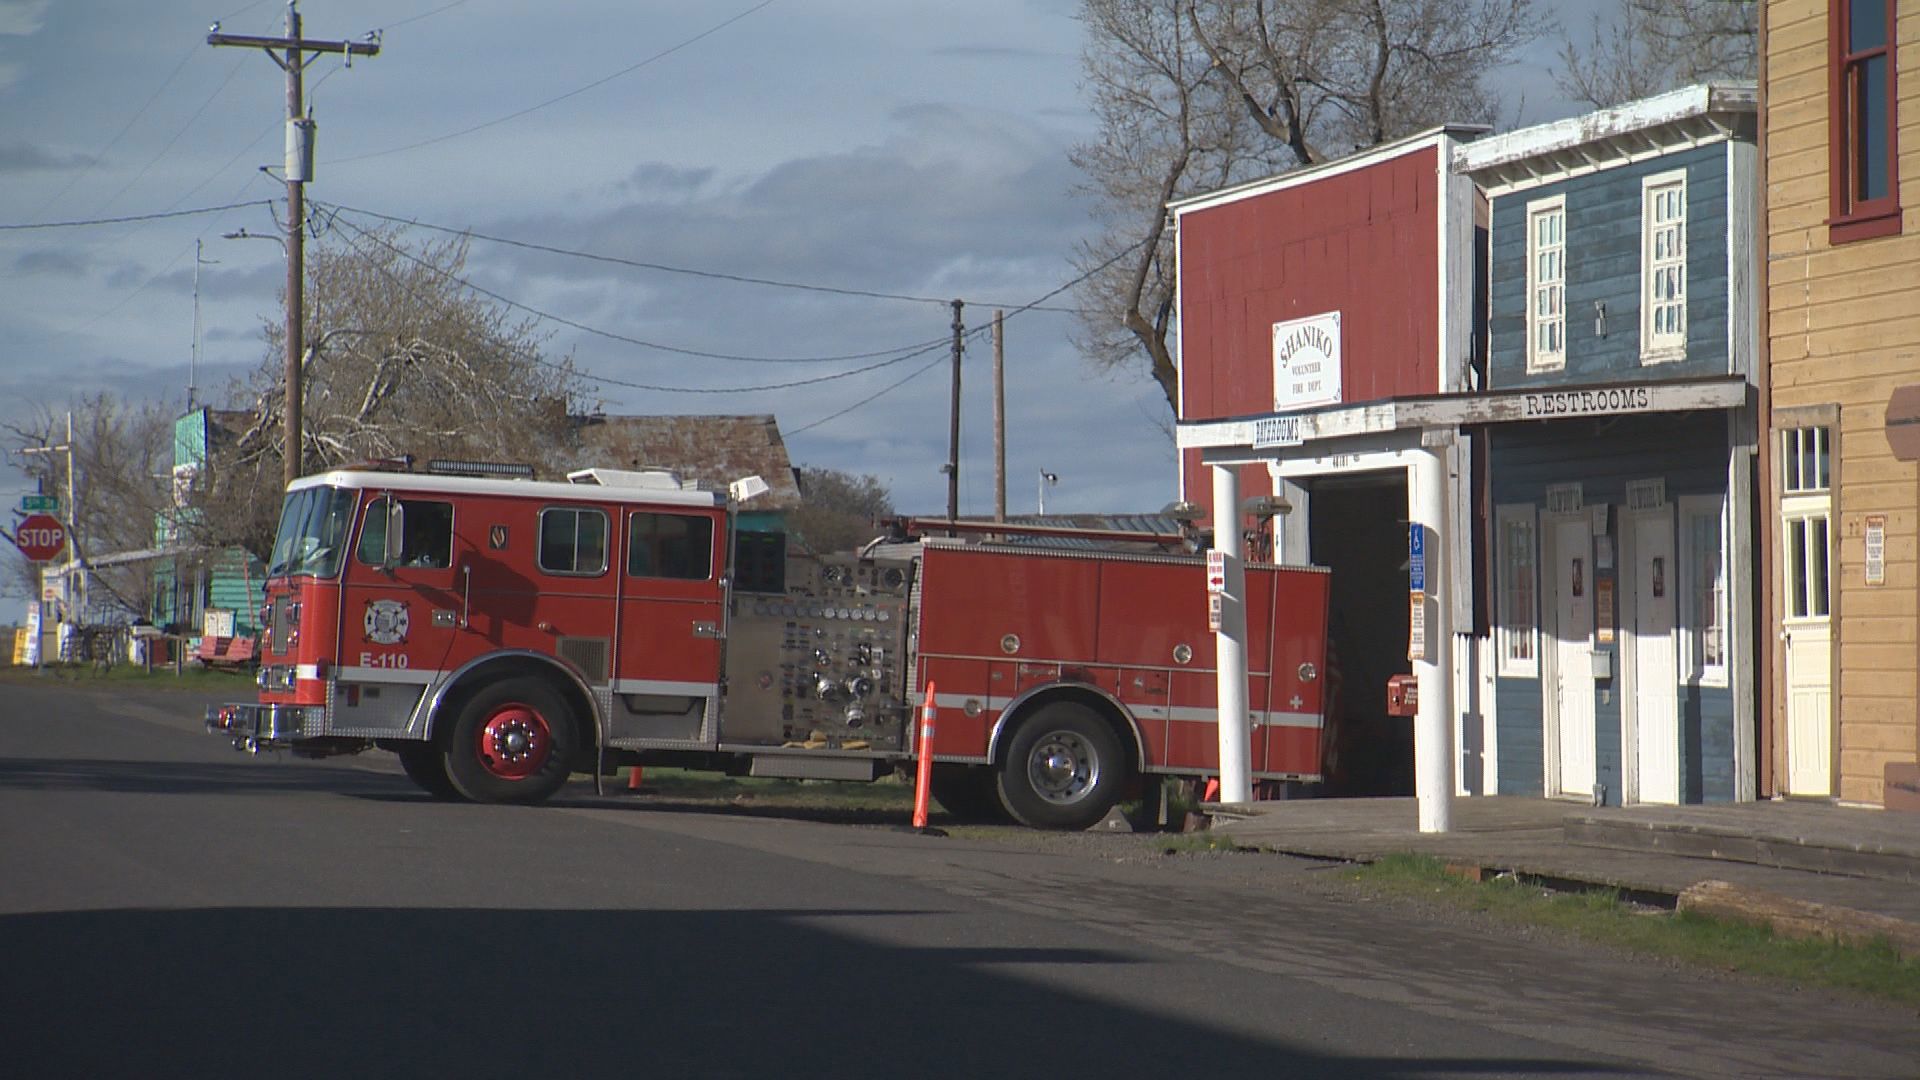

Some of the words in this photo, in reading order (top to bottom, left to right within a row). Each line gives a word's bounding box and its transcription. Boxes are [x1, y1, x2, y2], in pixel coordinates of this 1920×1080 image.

[1280, 325, 1333, 369] SHANIKO
[1291, 361, 1321, 376] VOLUNTEER
[1292, 383, 1304, 395] FIRE
[1526, 387, 1649, 416] RESTROOMS
[20, 528, 63, 547] STOP
[360, 652, 408, 669] E-110
